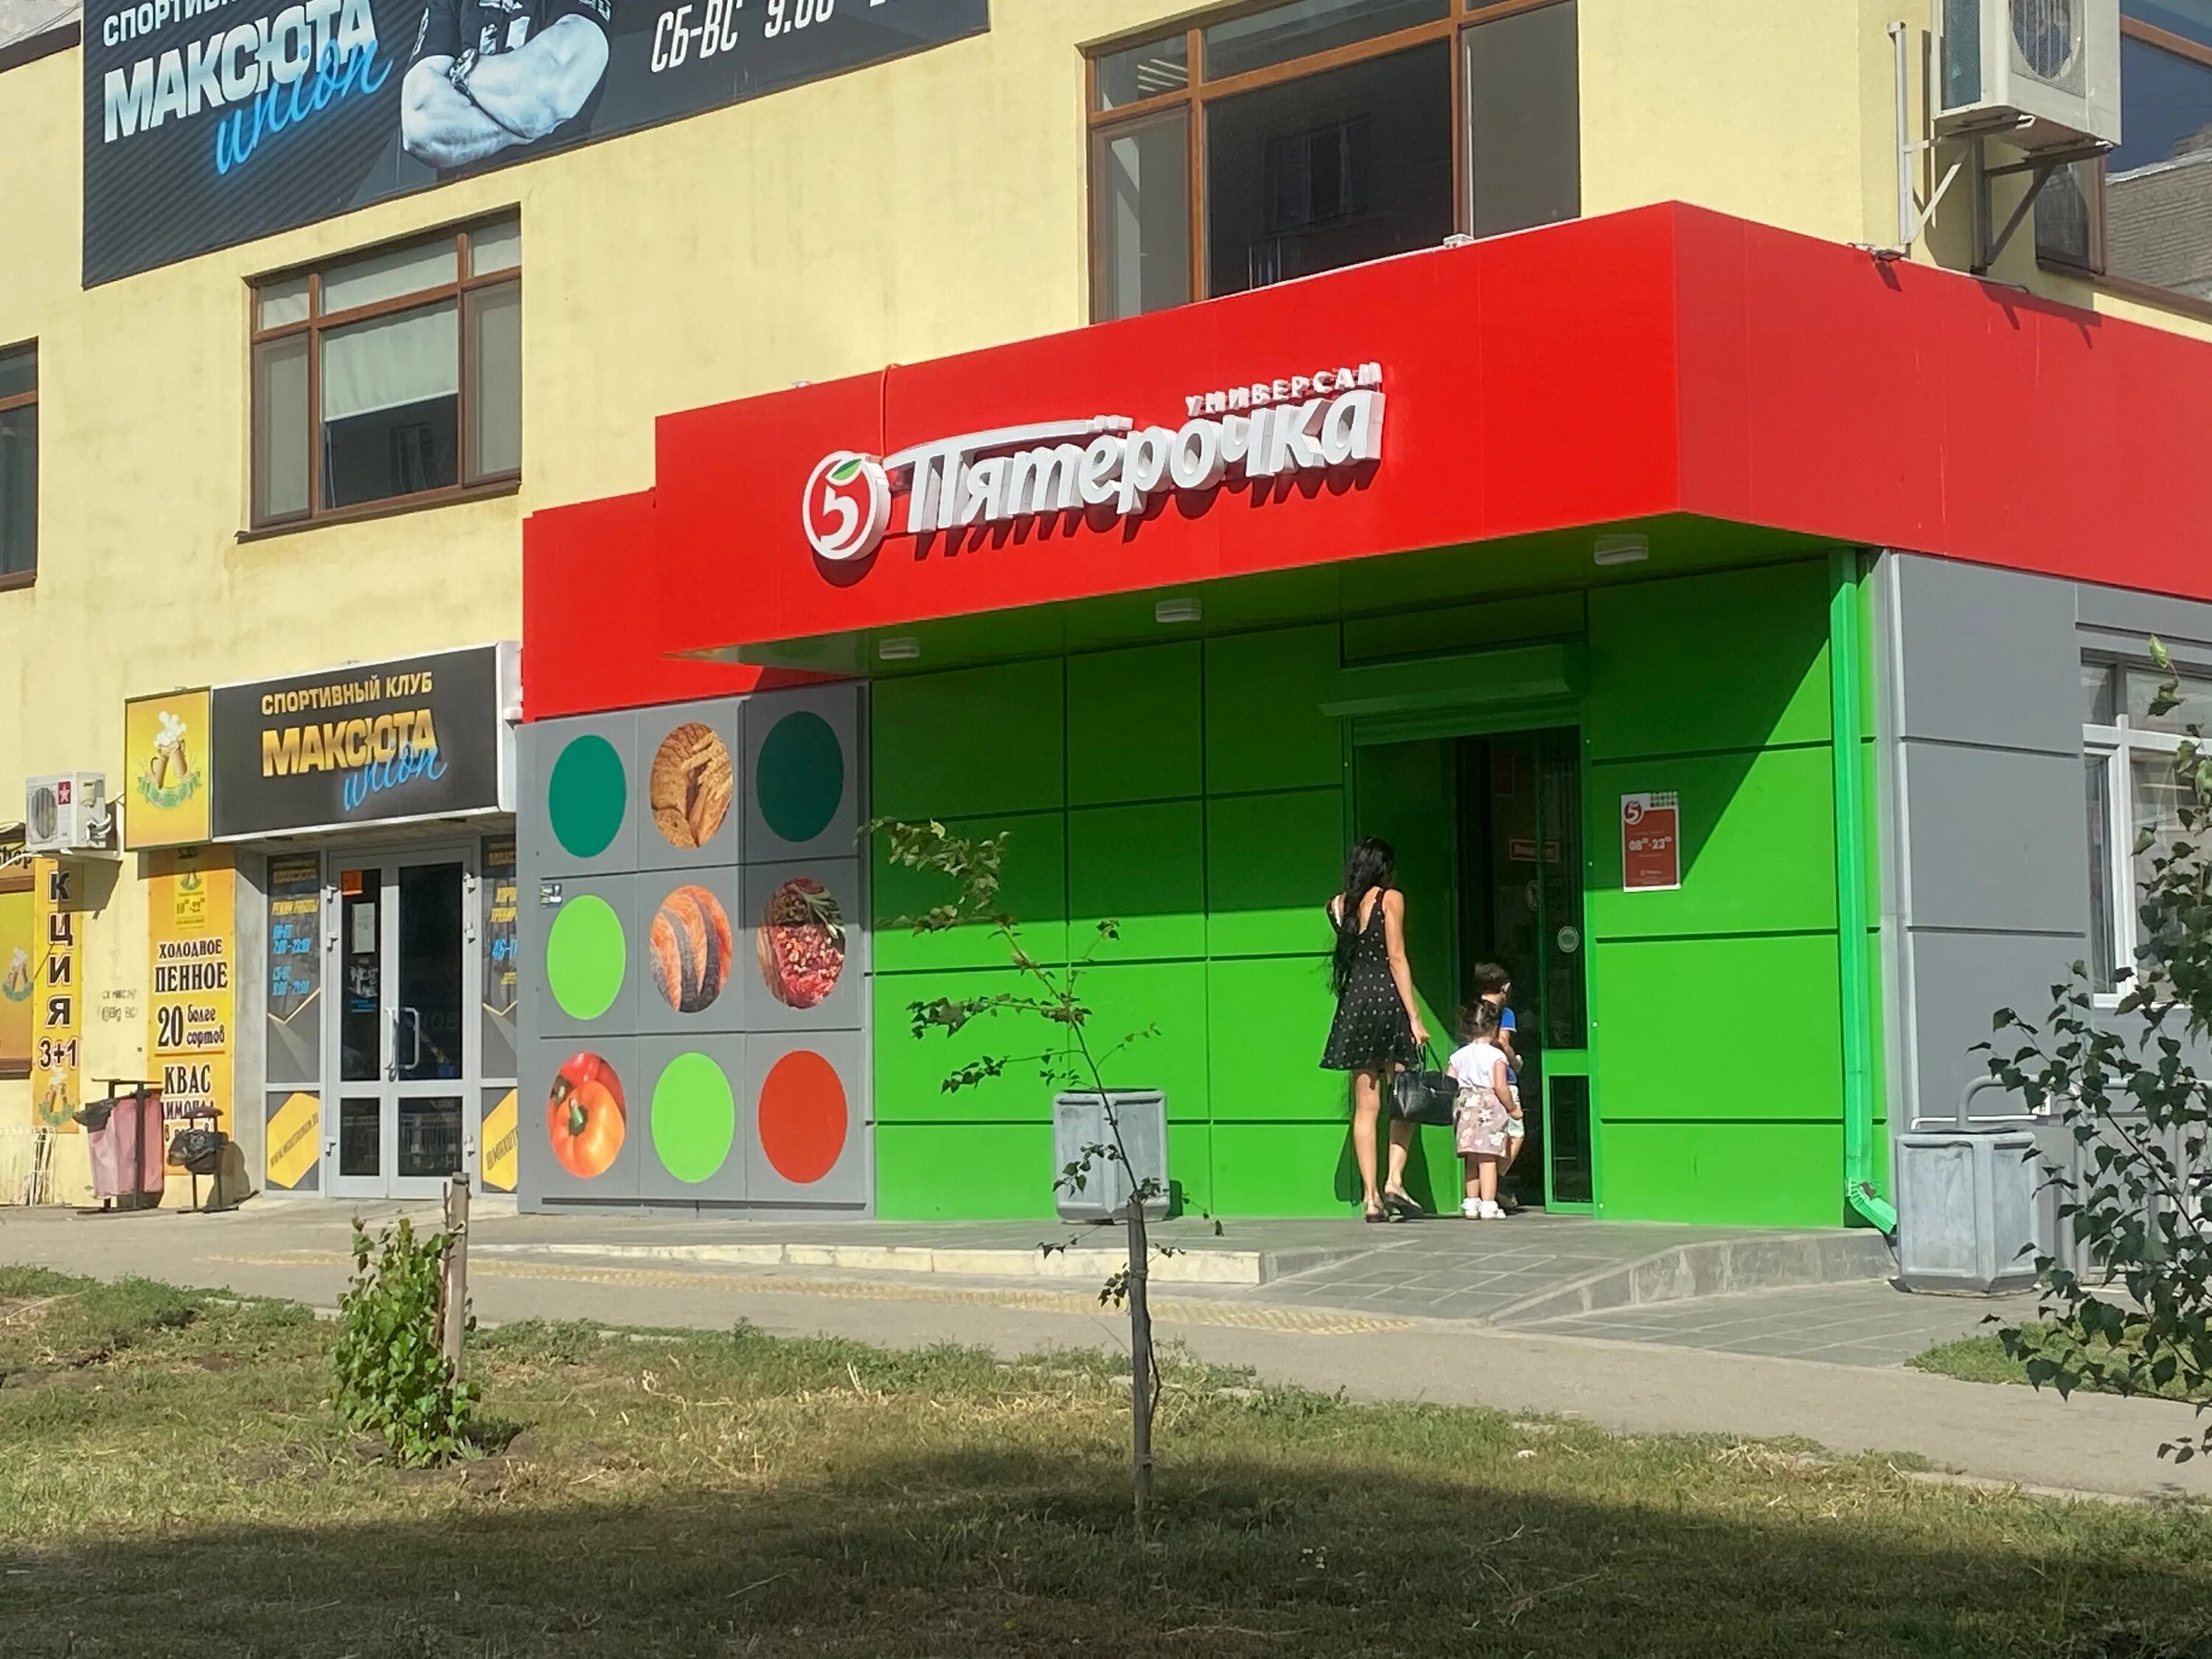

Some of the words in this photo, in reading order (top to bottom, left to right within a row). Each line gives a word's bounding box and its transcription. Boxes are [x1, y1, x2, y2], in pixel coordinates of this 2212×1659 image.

[104, 0, 378, 144] МАКСЮТА
[215, 38, 393, 175] union
[1185, 361, 1382, 417] УНИВЕРСАМ
[261, 674, 380, 715] СПОРТИВНЫЙ
[386, 671, 434, 698] КЛУБ
[262, 709, 438, 777] МАКСЮТА
[159, 939, 223, 959] ХОЛОДНОЕ
[155, 961, 228, 992] ПЕННОЕ
[157, 1005, 184, 1047] 20
[187, 1004, 216, 1023] более
[39, 1037, 79, 1067] 3+1
[186, 1024, 225, 1048] сортов
[164, 1064, 211, 1093] КВАС
